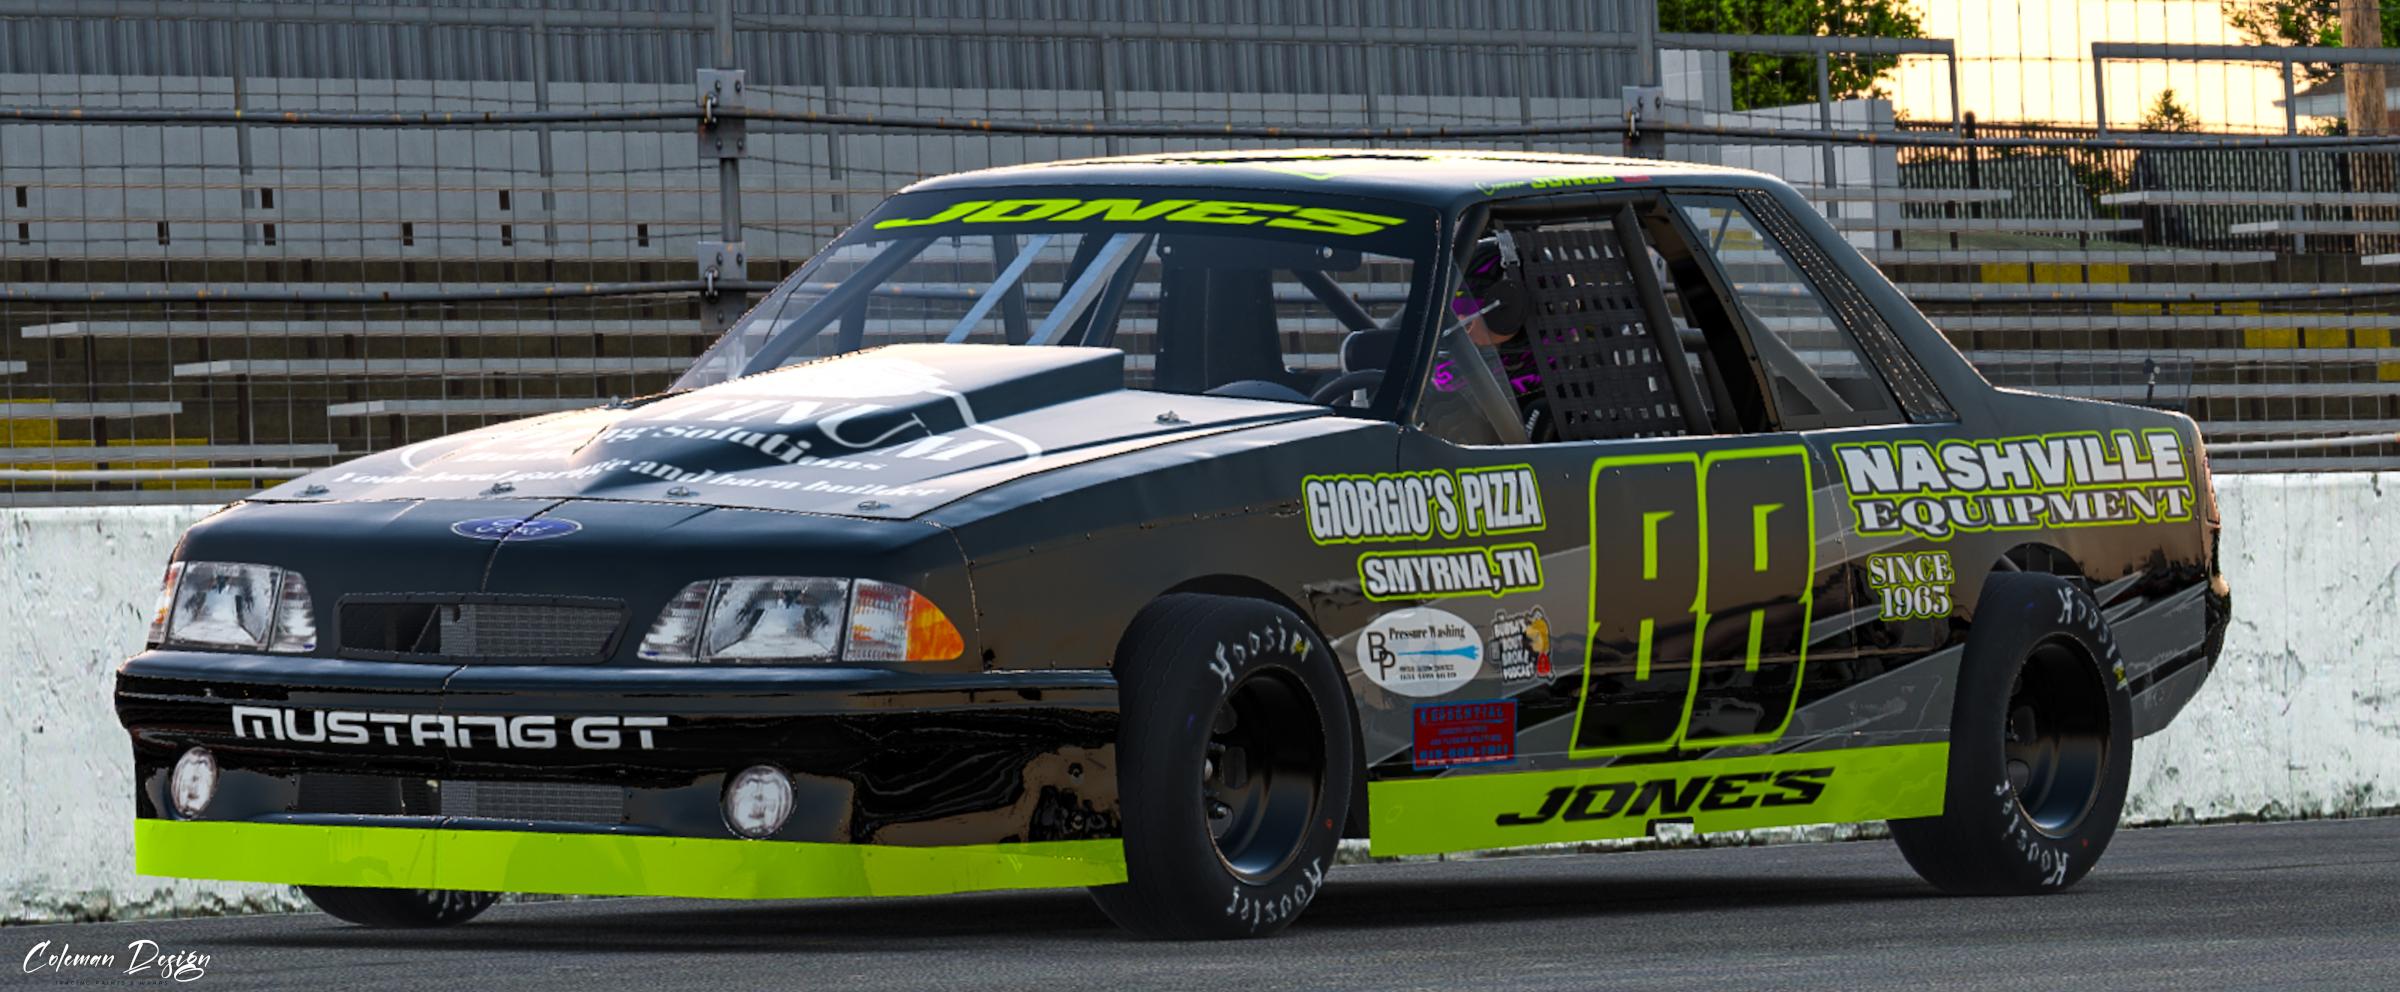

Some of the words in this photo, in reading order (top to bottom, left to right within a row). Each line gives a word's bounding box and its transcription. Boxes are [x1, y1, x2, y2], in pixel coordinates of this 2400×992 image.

[873, 198, 1407, 236] JONES
[653, 424, 889, 472] Solutions
[1838, 432, 2187, 494] NASHVILLE
[630, 458, 716, 483] and
[707, 471, 802, 491] barn
[1305, 477, 1460, 540] GIORGIO'S
[1460, 469, 1543, 531] PIZZA
[1854, 486, 2195, 536] EQUIPMENT
[1362, 548, 1539, 595] SMYRNA,TN
[1869, 553, 1953, 586] SINCE
[1569, 445, 1816, 760] 88
[1880, 584, 1951, 618] 1965
[1388, 626, 1428, 641] Pressure
[1428, 624, 1467, 641] Washing
[1502, 662, 1535, 680] PODCAST
[231, 705, 557, 749] MUSTANG
[571, 715, 668, 750] GT
[1494, 767, 1836, 826] JONES
